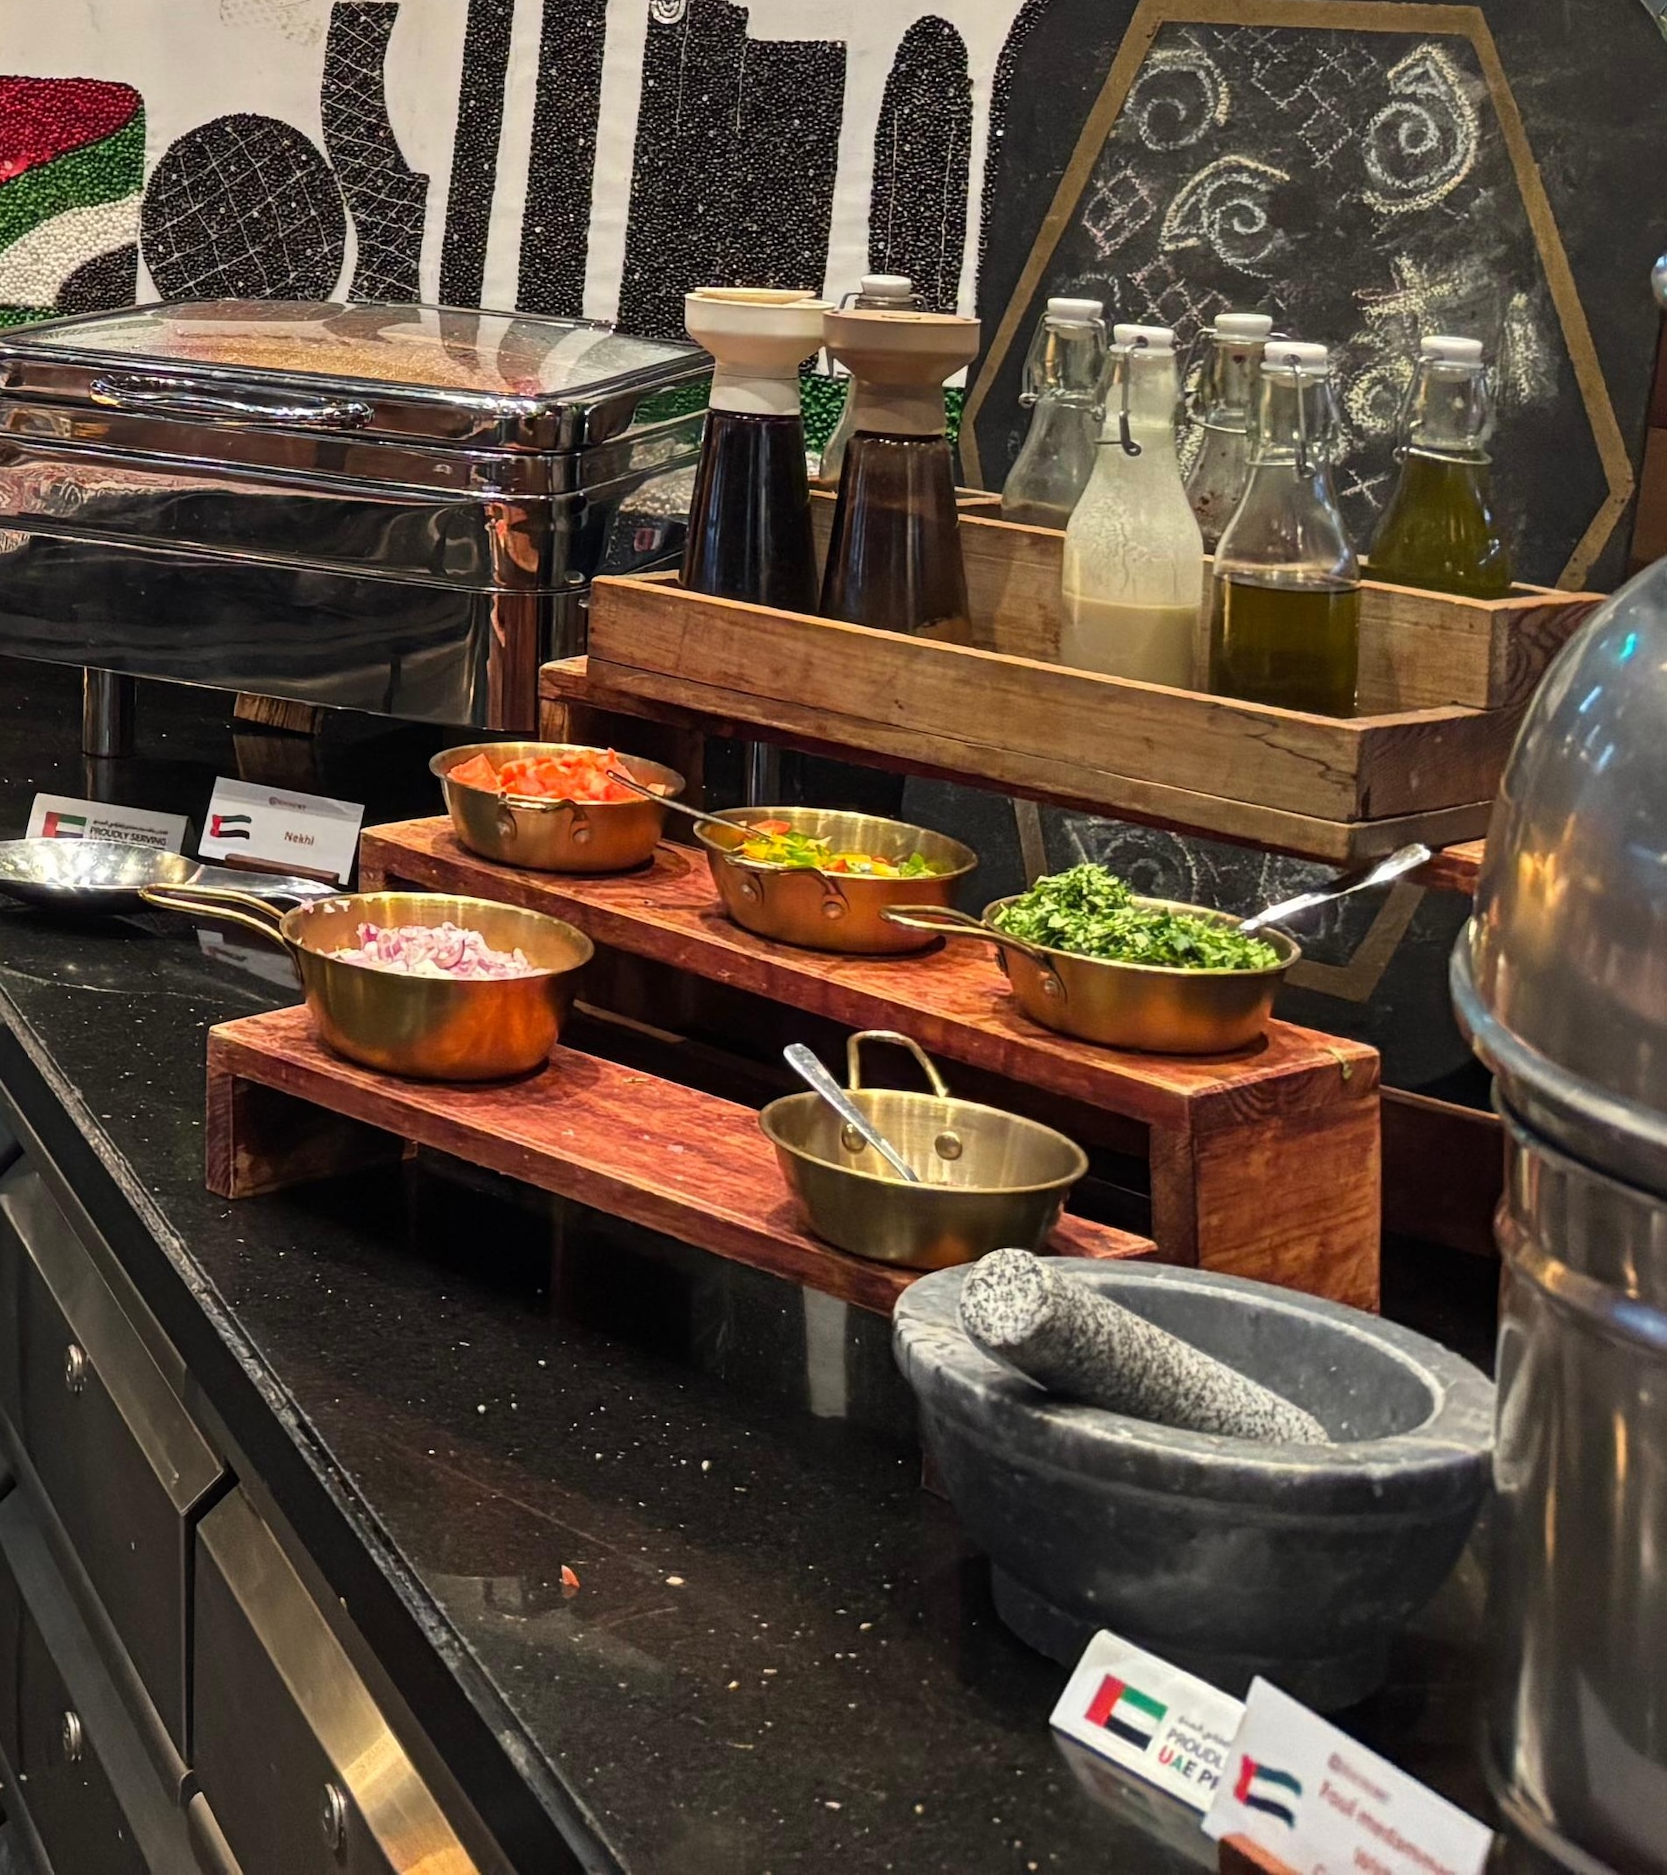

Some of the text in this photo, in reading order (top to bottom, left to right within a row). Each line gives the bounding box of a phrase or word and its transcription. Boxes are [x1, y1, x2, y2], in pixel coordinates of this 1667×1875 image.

[89, 826, 130, 840] PROUDLY
[130, 833, 167, 846] SERVING
[1157, 1744, 1199, 1779] UAE
[1166, 1727, 1224, 1771] PROUDL
